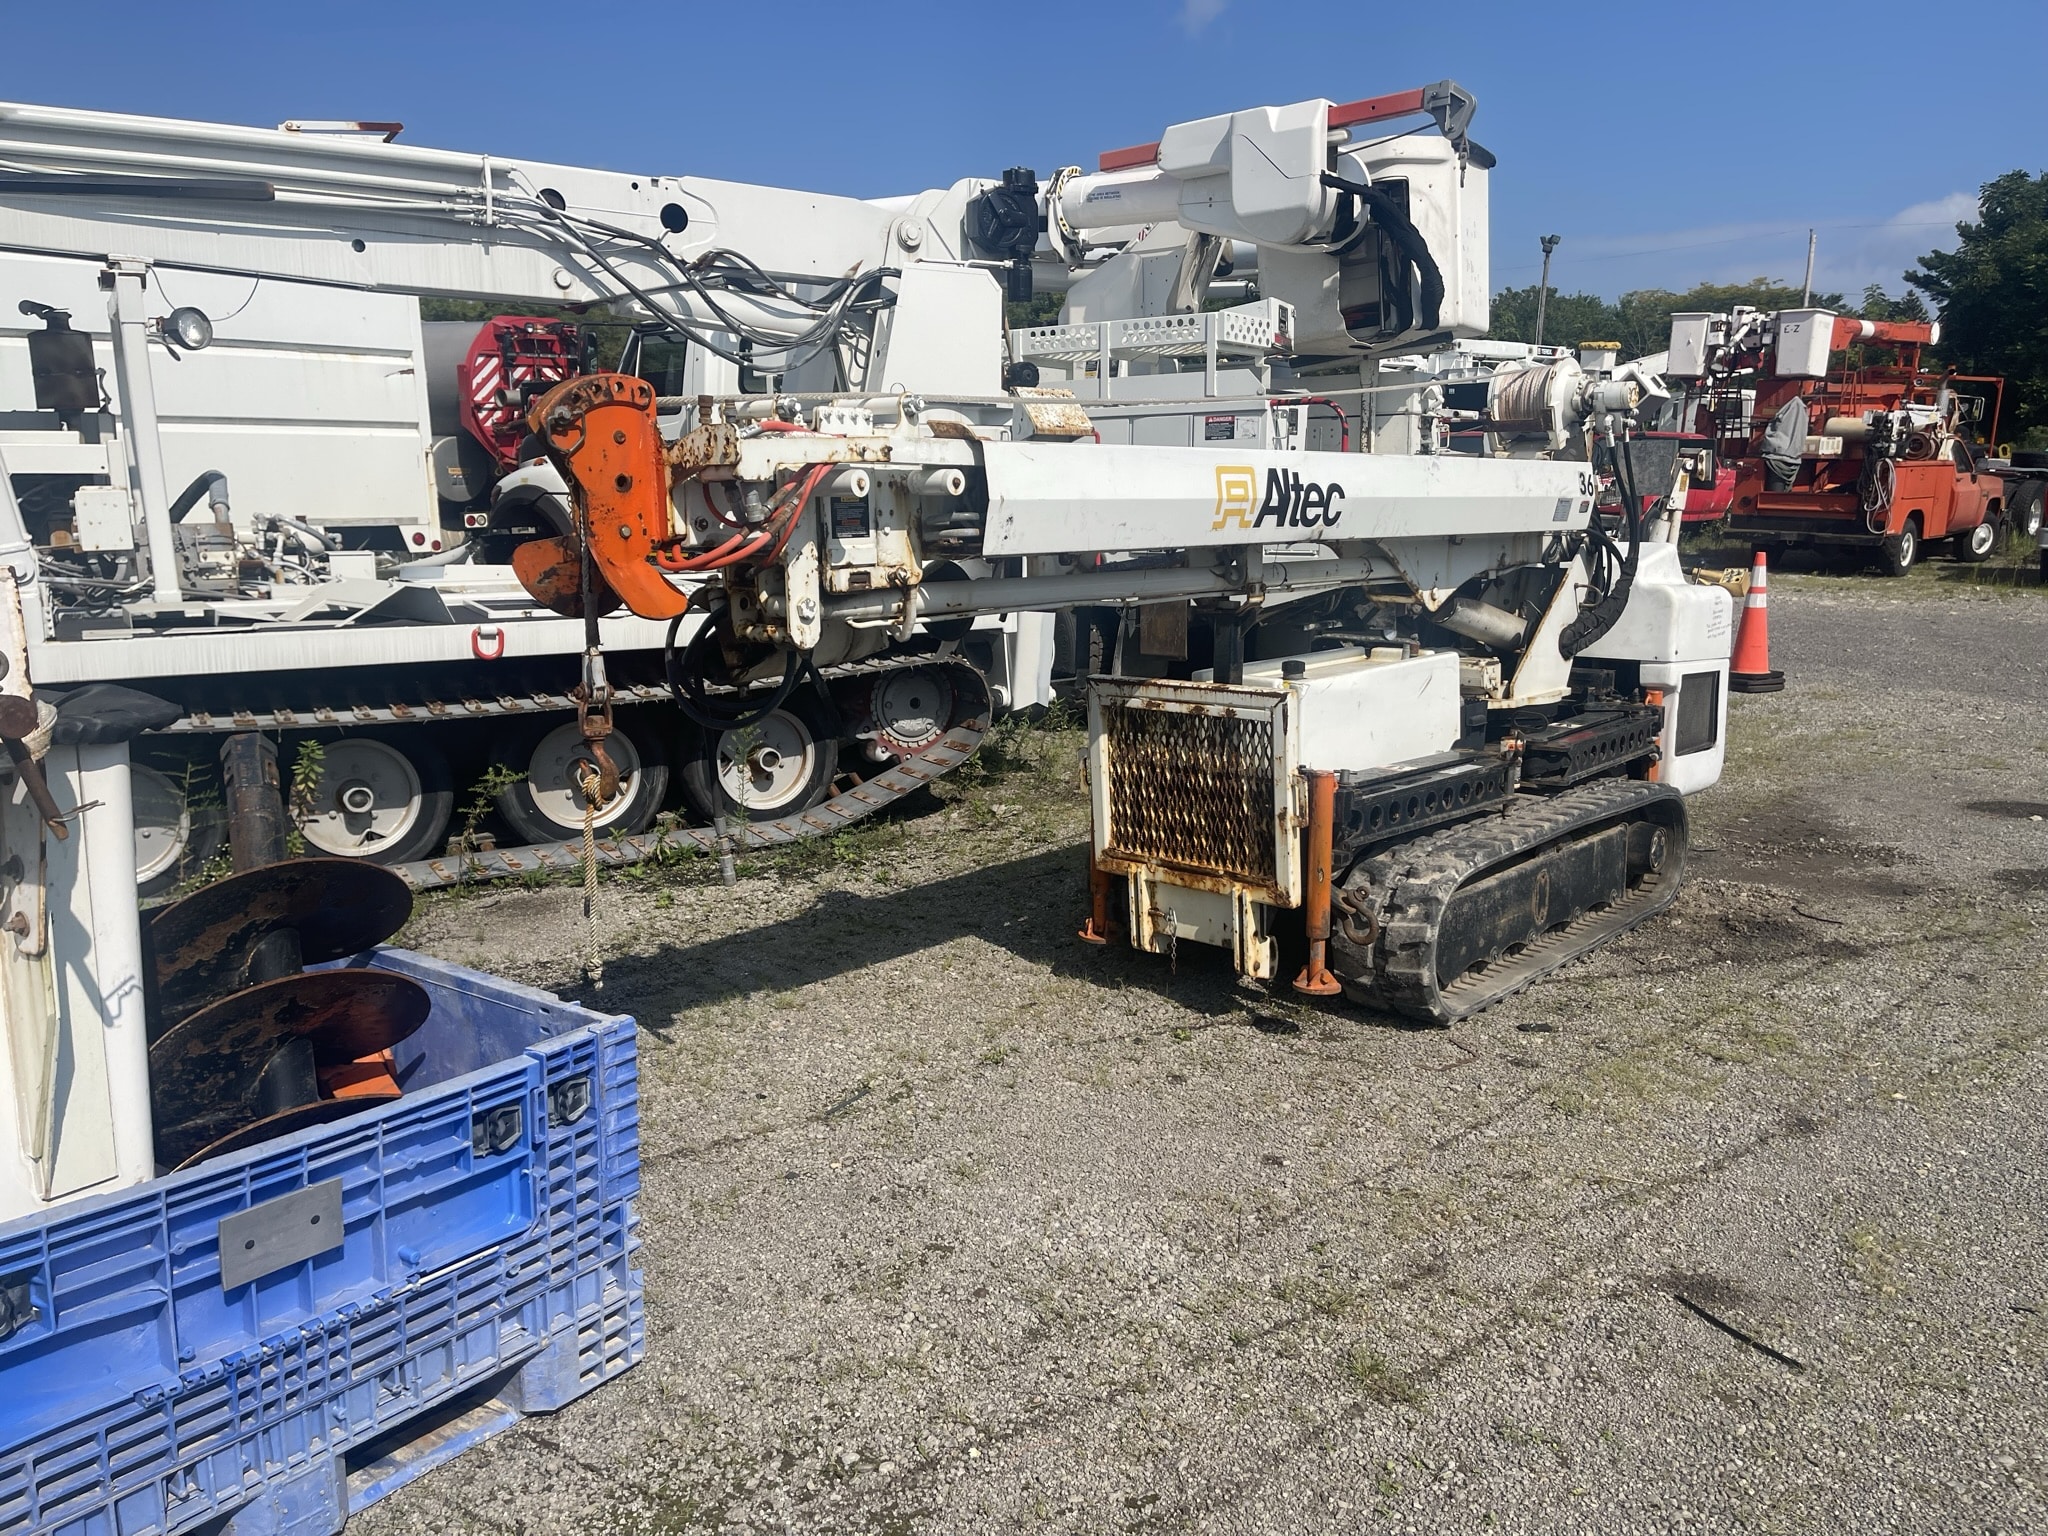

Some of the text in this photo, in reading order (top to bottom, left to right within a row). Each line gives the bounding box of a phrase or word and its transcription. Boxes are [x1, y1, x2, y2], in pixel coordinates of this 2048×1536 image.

[1784, 324, 1800, 334] E-Z
[1579, 472, 1594, 497] 36
[1252, 468, 1345, 528] Altec
